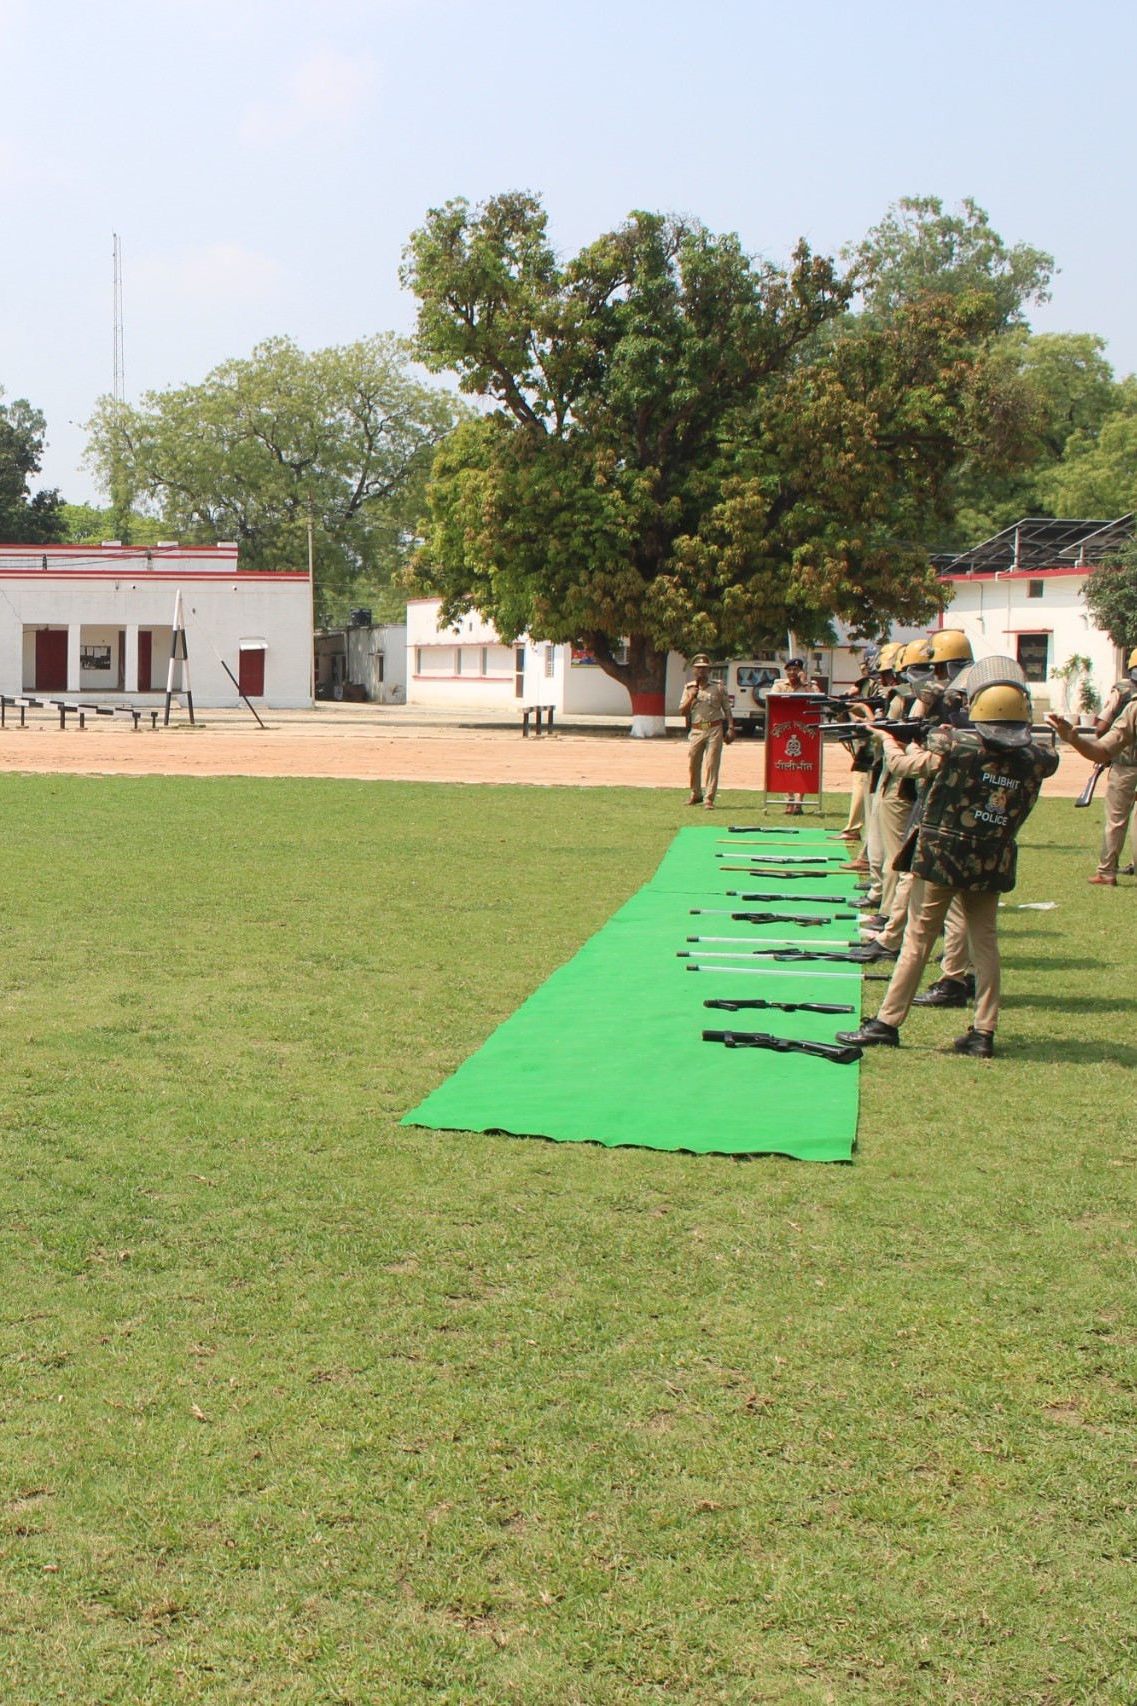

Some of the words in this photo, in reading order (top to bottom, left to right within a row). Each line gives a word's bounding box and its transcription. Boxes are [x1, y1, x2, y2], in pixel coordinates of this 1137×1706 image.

[775, 760, 813, 771] पीलीभीत
[983, 773, 1020, 789] PILIBHIT
[974, 811, 1008, 826] POLICE
